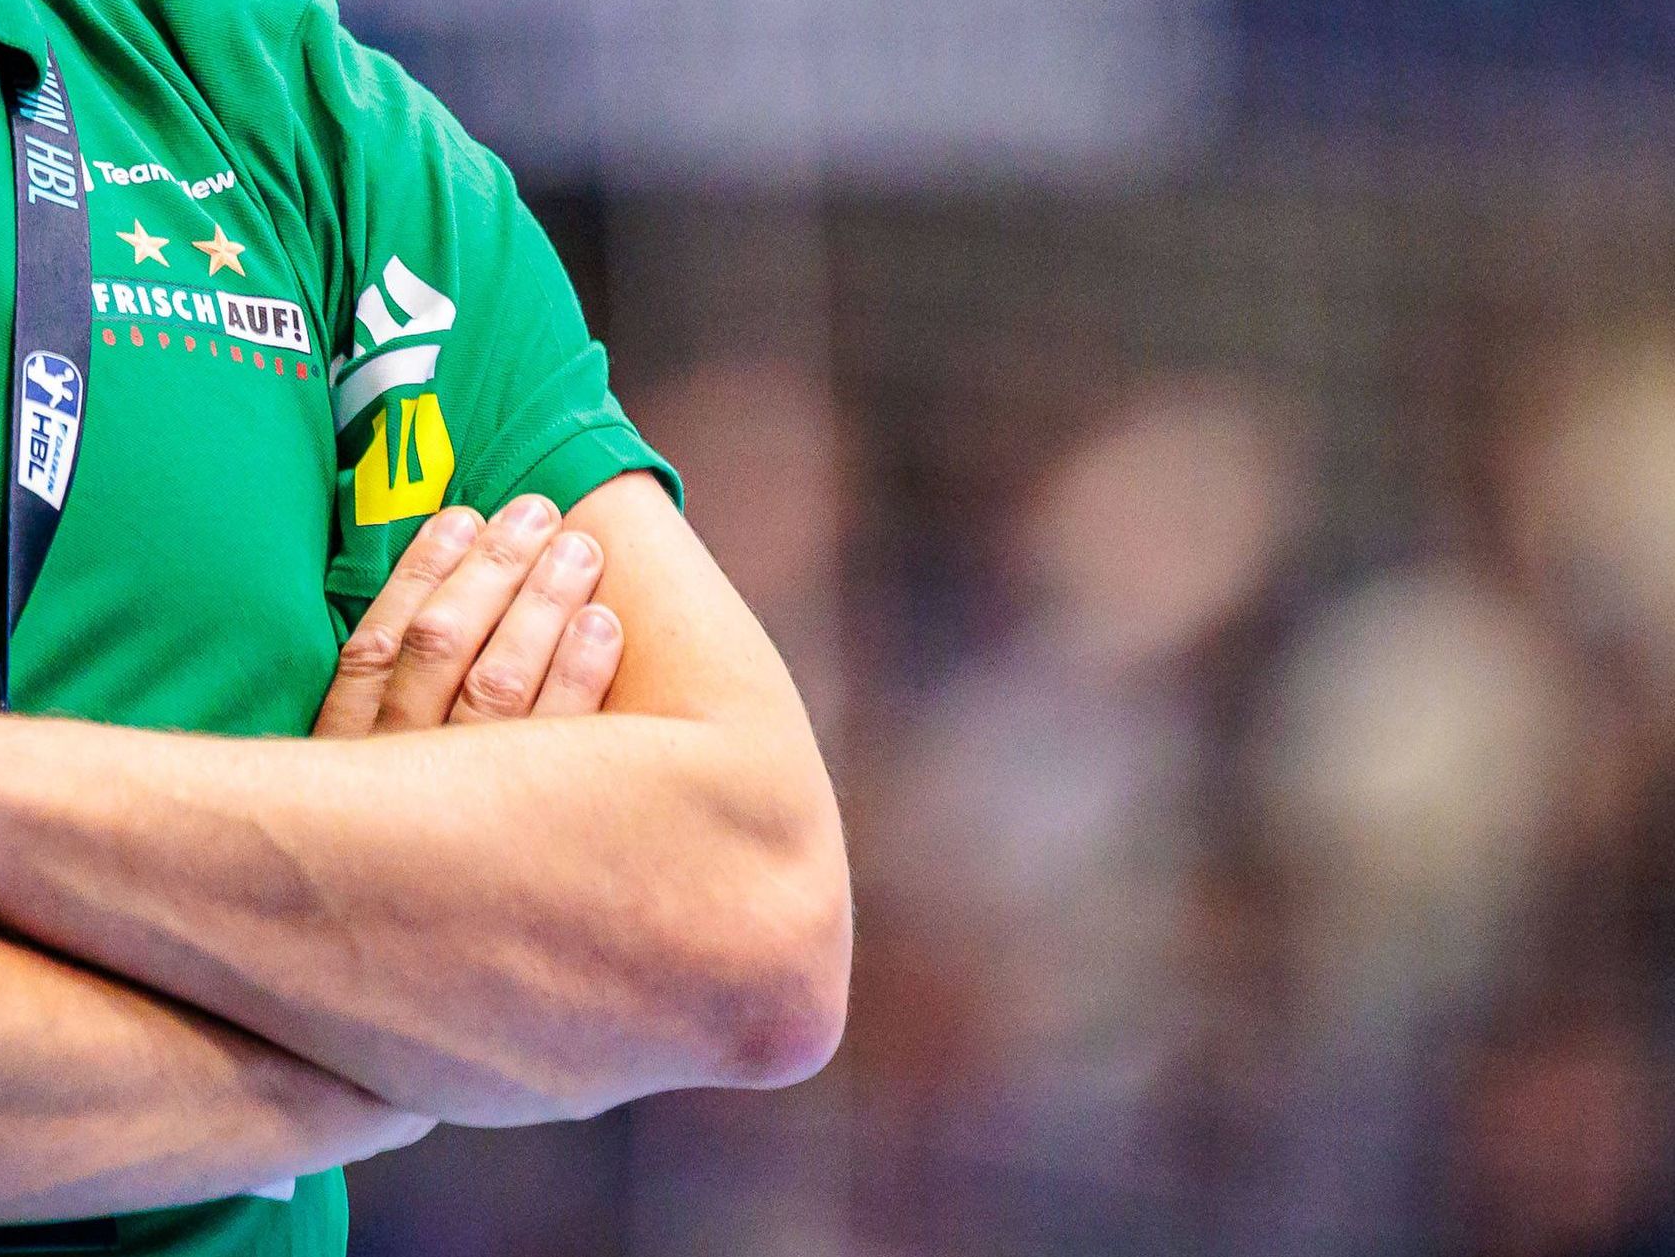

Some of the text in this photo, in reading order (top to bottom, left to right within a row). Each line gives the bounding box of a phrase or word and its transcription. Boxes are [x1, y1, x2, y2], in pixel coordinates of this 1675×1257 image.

[24, 134, 79, 210] HBL
[91, 282, 303, 344] FRISCH AUF!
[27, 411, 53, 481] HBL
